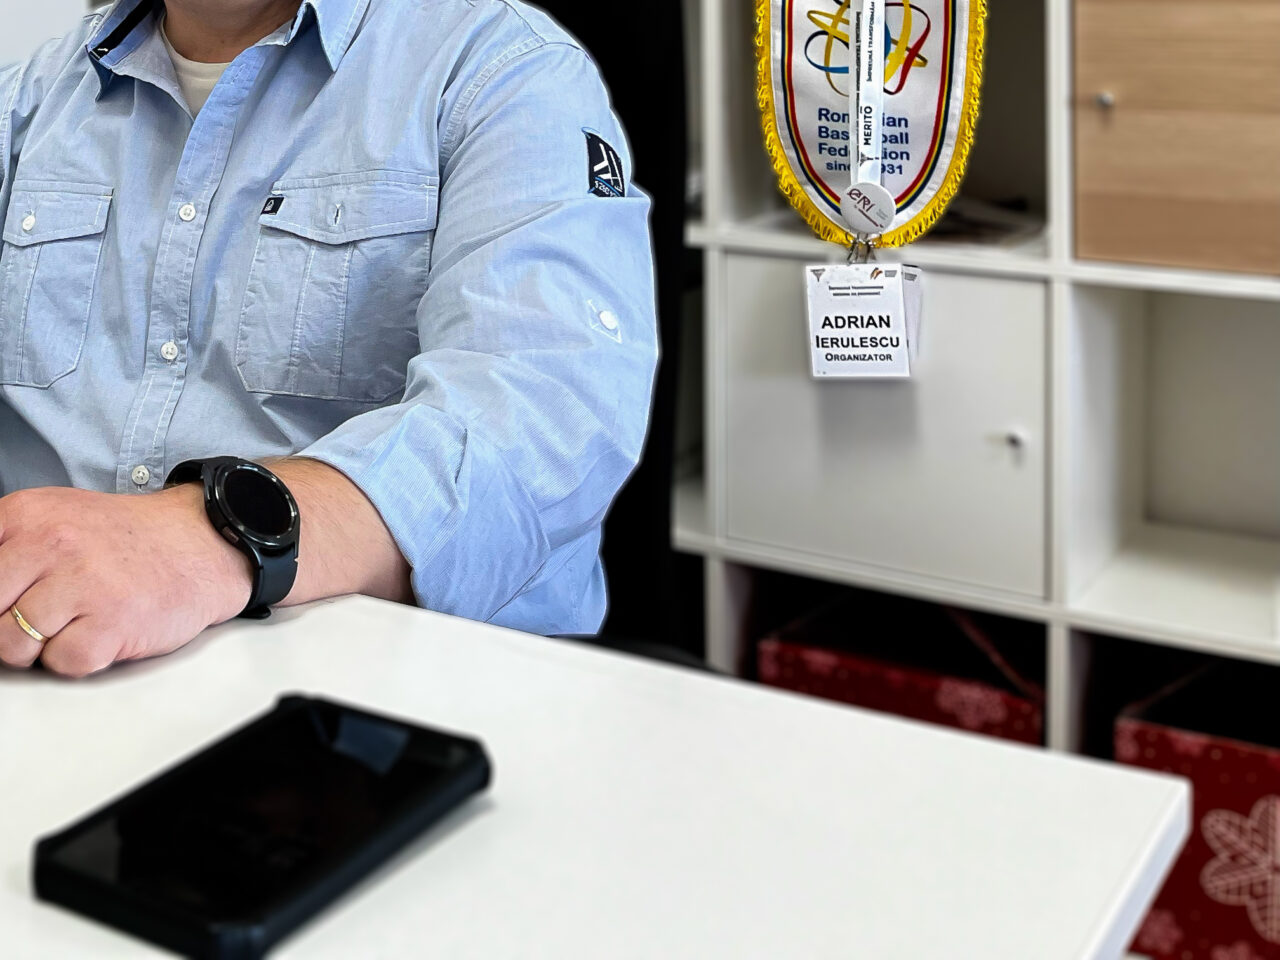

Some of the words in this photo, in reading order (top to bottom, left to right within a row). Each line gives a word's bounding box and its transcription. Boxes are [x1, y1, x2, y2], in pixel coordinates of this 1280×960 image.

[879, 163, 904, 175] 931
[821, 315, 891, 329] ADRIAN
[815, 335, 900, 348] IERULESCU
[825, 353, 893, 362] ORGANIZATOR
